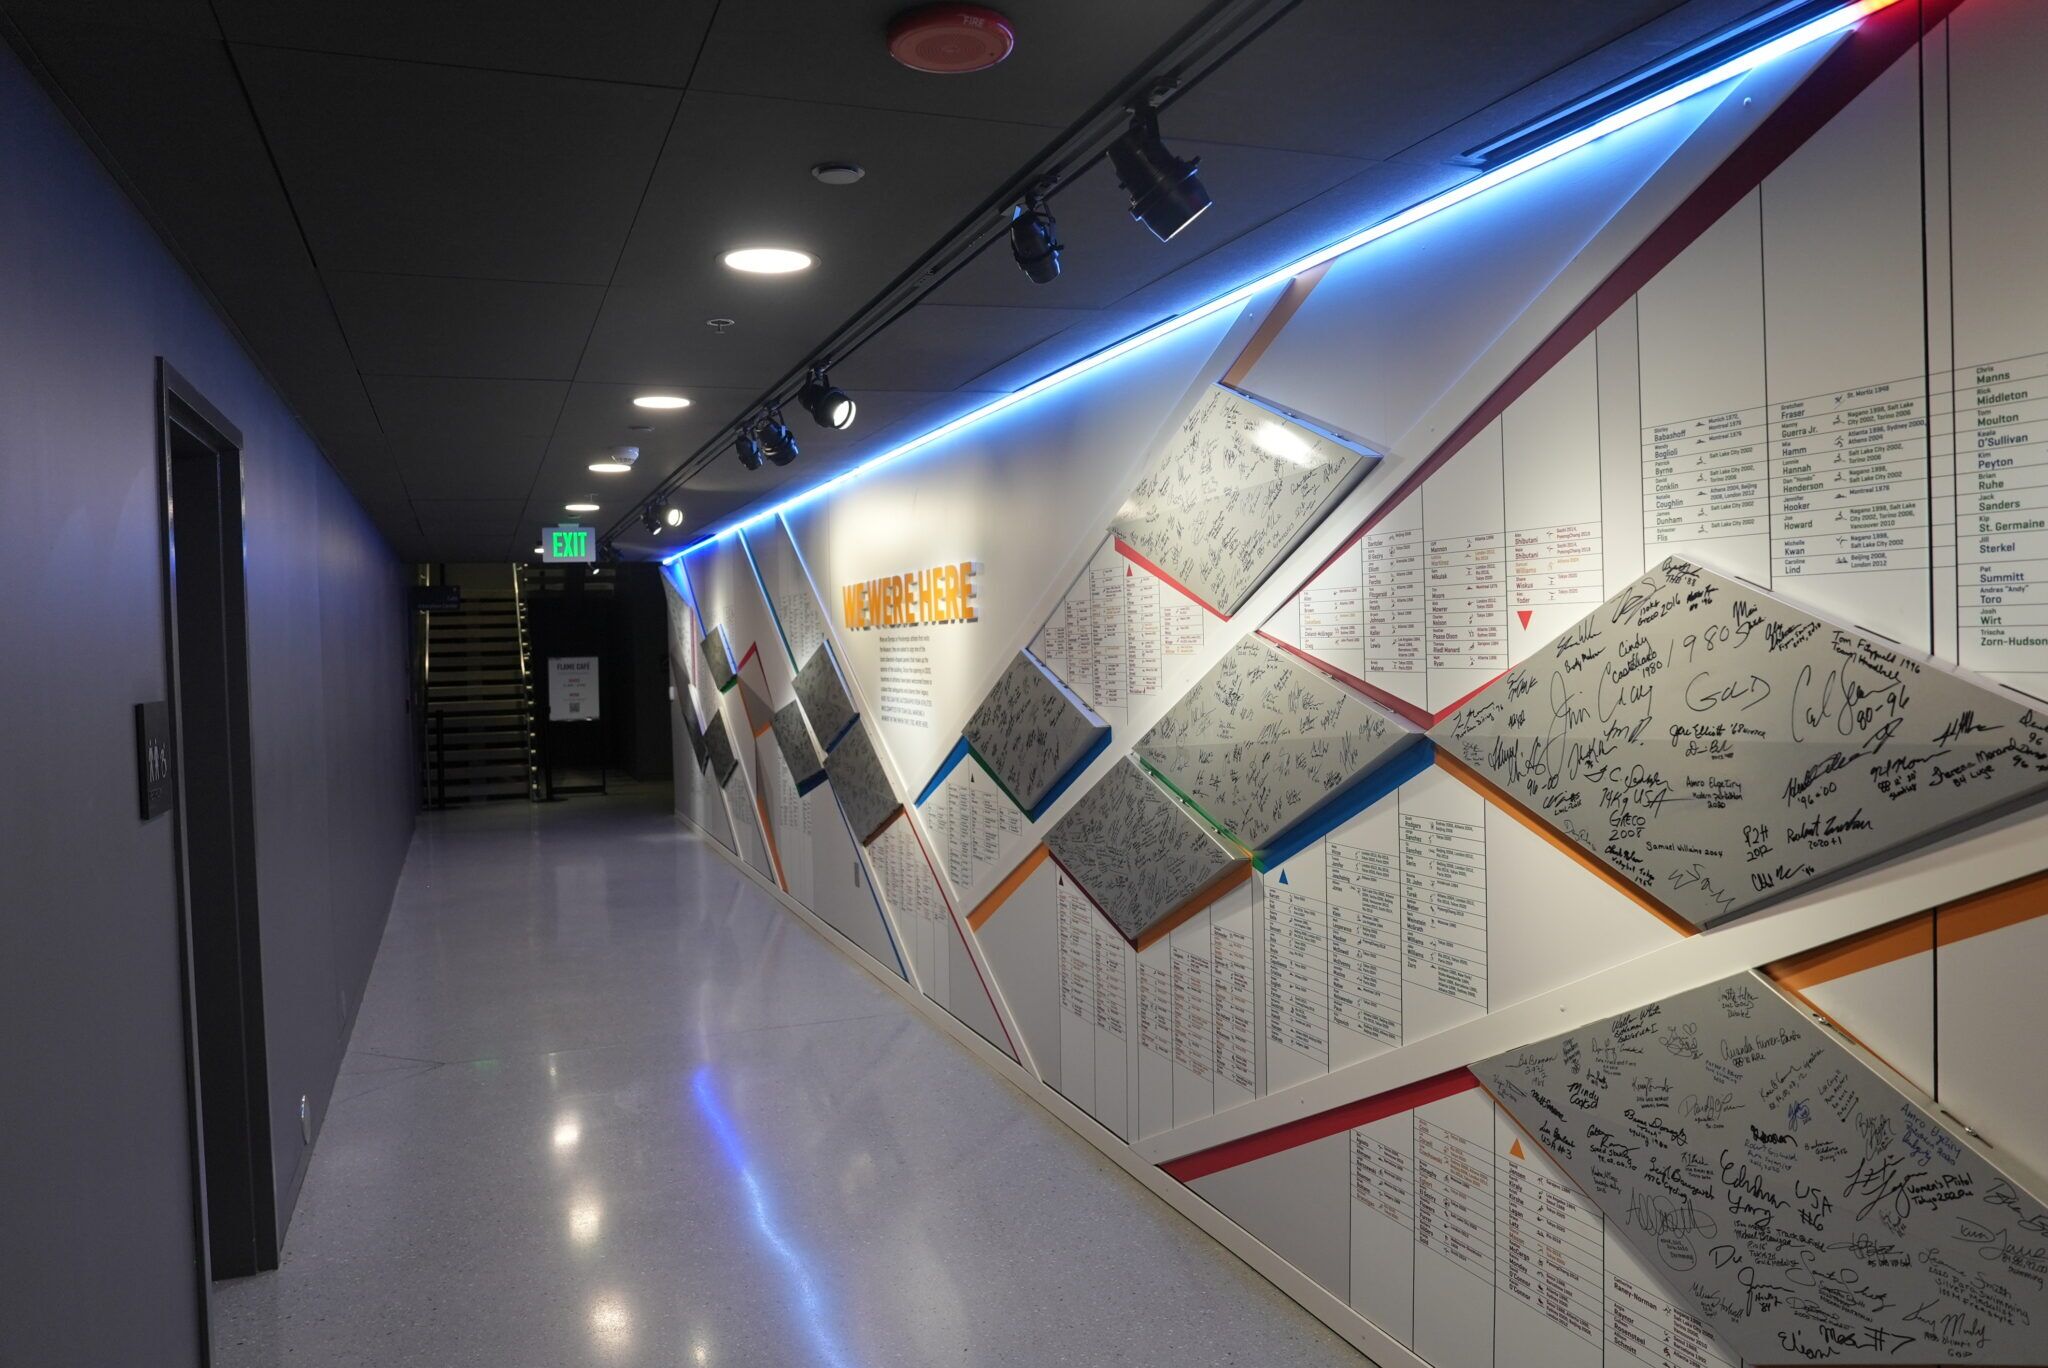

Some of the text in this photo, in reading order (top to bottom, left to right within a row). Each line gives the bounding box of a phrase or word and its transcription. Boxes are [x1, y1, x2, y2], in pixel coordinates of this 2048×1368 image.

[1976, 366, 1994, 374] Chris
[1977, 372, 2011, 385] Manns
[1978, 390, 2028, 406] Middleton
[1781, 410, 1805, 420] Fraser
[1978, 414, 2019, 427] Moulton
[1848, 418, 1858, 426] City
[1654, 430, 1686, 442] Babashoff
[1782, 426, 1818, 439] Guerra Jr.
[1978, 434, 2029, 448] O'Sullivan
[1655, 448, 1678, 459] Boglioli
[1782, 447, 1807, 457] Hamm
[1783, 464, 1812, 475] Hannah
[1979, 458, 2013, 471] Peyton
[1655, 468, 1673, 476] Byrne
[1875, 473, 1886, 481] City
[1656, 482, 1679, 492] Conklin
[1784, 482, 1824, 494] Henderson
[1979, 481, 2004, 491] Ruhe
[1656, 499, 1683, 510] Coughlin
[1784, 502, 1810, 512] Hooker
[1979, 501, 2021, 512] Sanders
[1657, 517, 1683, 525] Dunham
[1851, 514, 1861, 522] City
[1784, 520, 1813, 530] Howard
[1980, 520, 2045, 533] St. Germaine
[1657, 534, 1668, 542] Flis
[553, 532, 588, 558] EXIT
[1876, 540, 1887, 548] City
[1980, 542, 2016, 554] Sterkel
[1785, 548, 1805, 556] Kwan
[1786, 566, 1801, 575] Lind
[1980, 572, 2025, 583] Summitt
[843, 561, 975, 629] WE WERE HERE
[1981, 595, 2002, 604] Toro
[1981, 616, 2002, 625] Wirt
[1618, 633, 1652, 658] Cindy
[1667, 624, 1730, 668] 1980
[1981, 637, 2048, 647] Zorn-Hudson
[1833, 630, 1921, 674] Tom 1996
[1642, 661, 1663, 678] 1980
[1646, 841, 1675, 852] Samuel
[1795, 1180, 1833, 1217] USA
